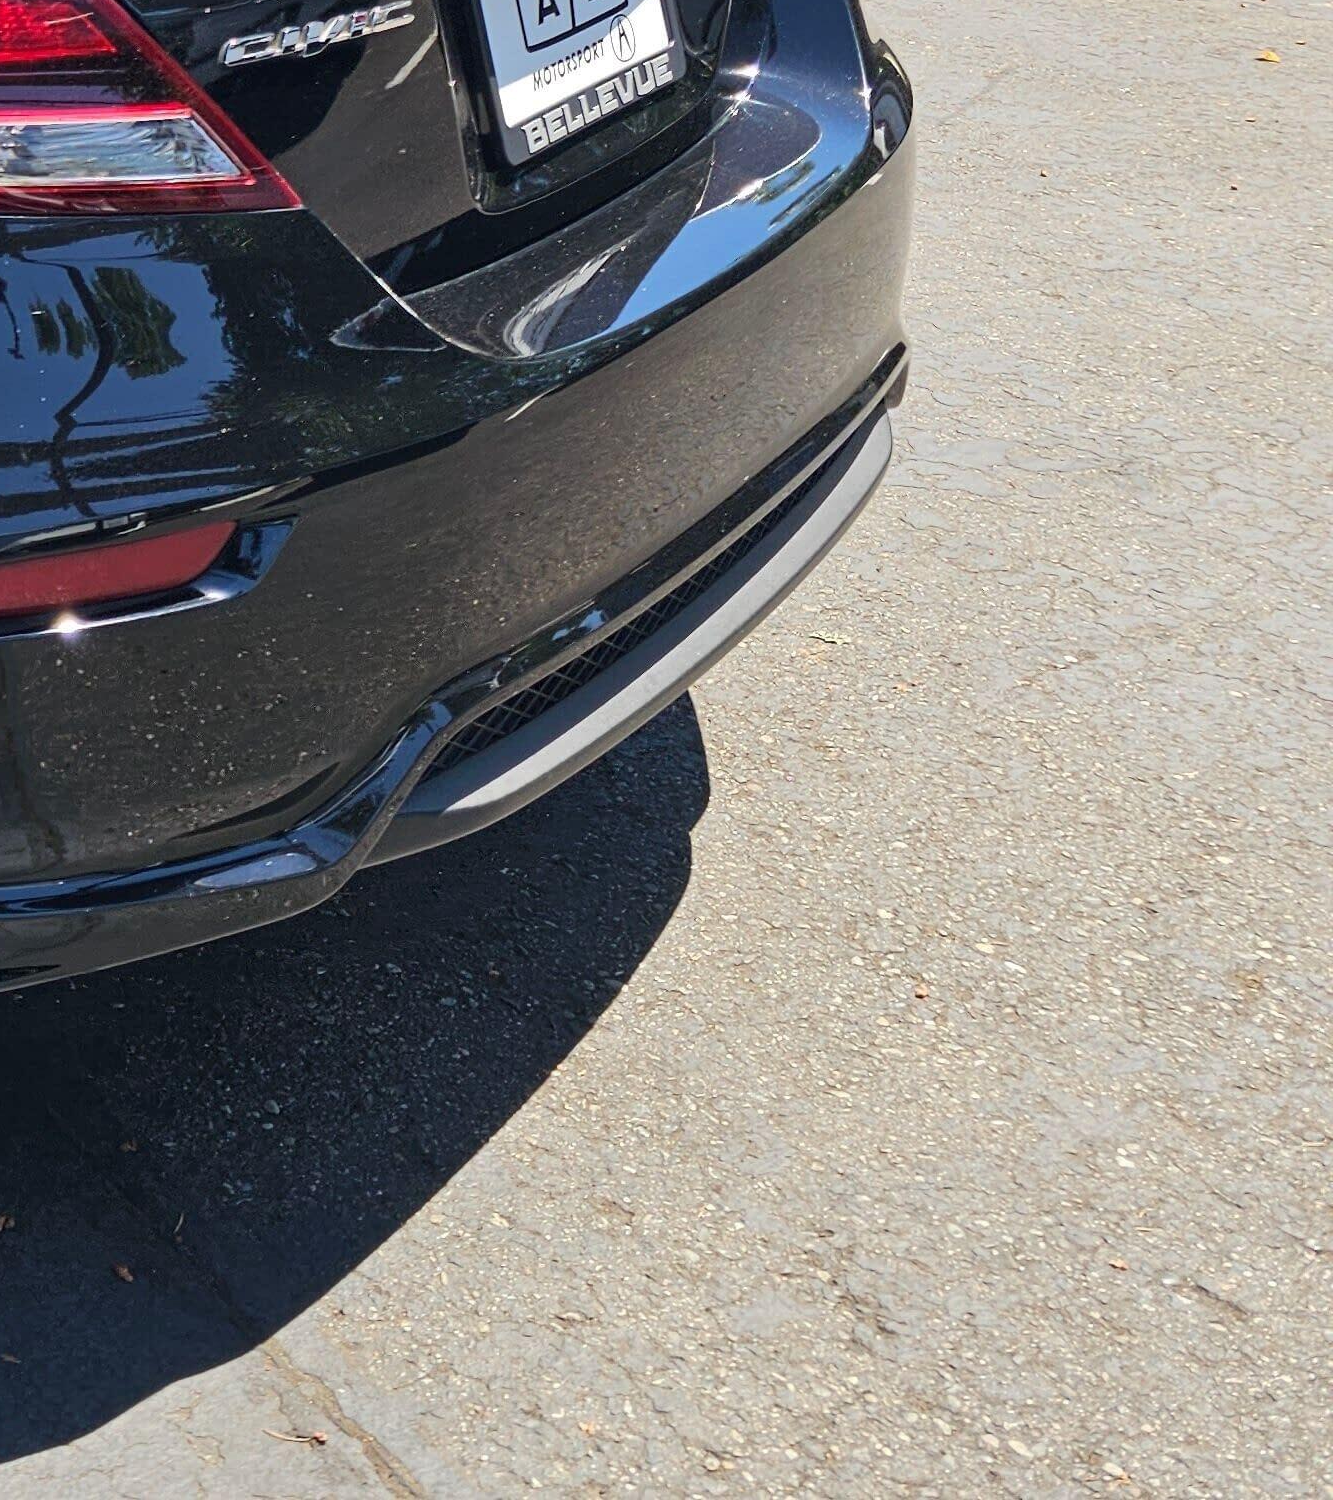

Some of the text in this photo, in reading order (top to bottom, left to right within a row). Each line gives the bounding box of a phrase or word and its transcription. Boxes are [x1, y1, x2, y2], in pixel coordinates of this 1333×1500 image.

[219, 0, 416, 67] CIVIC
[533, 38, 605, 91] MOTORSPORT
[521, 52, 674, 155] BELLEVUE
